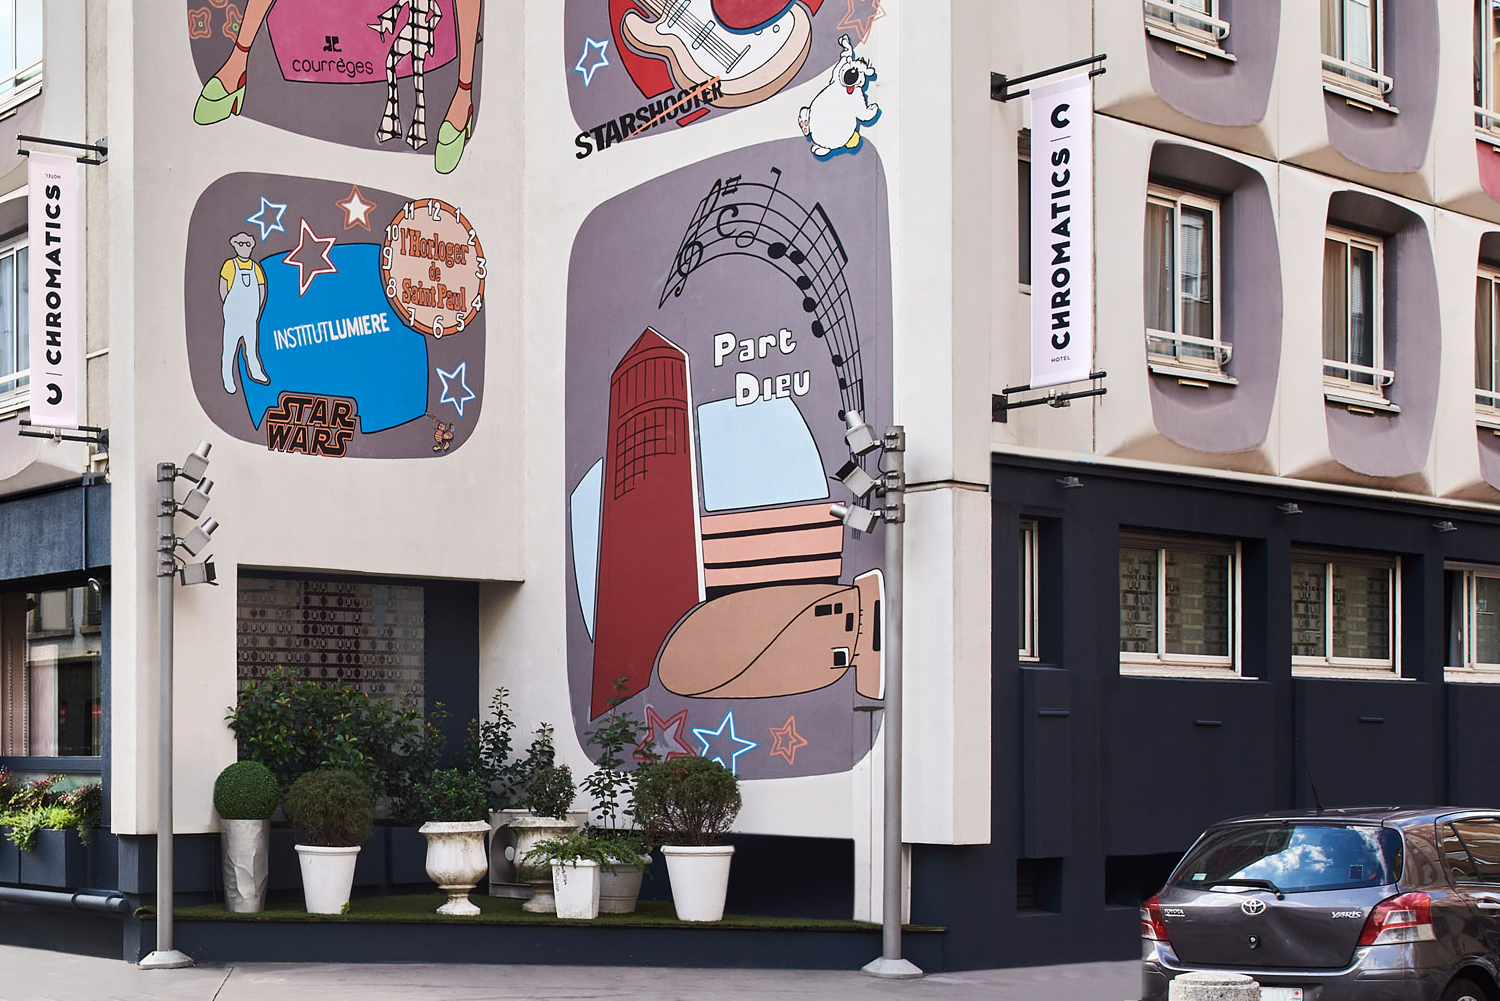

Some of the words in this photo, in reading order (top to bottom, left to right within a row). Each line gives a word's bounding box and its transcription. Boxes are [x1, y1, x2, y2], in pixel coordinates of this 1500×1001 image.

[292, 58, 374, 78] courrèges
[574, 79, 724, 160] STARSHOOTER
[1050, 103, 1071, 129] C
[403, 202, 415, 220] 11
[427, 199, 441, 221] 12
[454, 207, 461, 224] 1
[386, 225, 399, 241] 10
[467, 229, 476, 246] 2
[382, 247, 393, 270] 9
[1051, 148, 1071, 350] CHROMATICS
[45, 184, 62, 365] CHROMATICS
[429, 261, 441, 282] de
[475, 257, 487, 279] 3
[386, 278, 397, 298] 8
[402, 278, 436, 307] Saint
[437, 283, 467, 312] Paul
[471, 294, 482, 311] 4
[407, 307, 416, 327] 7
[433, 315, 444, 339] 6
[455, 313, 465, 332] 5
[713, 327, 797, 368] Part
[1050, 355, 1071, 363] HOTEL
[267, 395, 357, 429] STAR
[267, 422, 355, 458] WARS
[1331, 910, 1362, 919] YARIS
